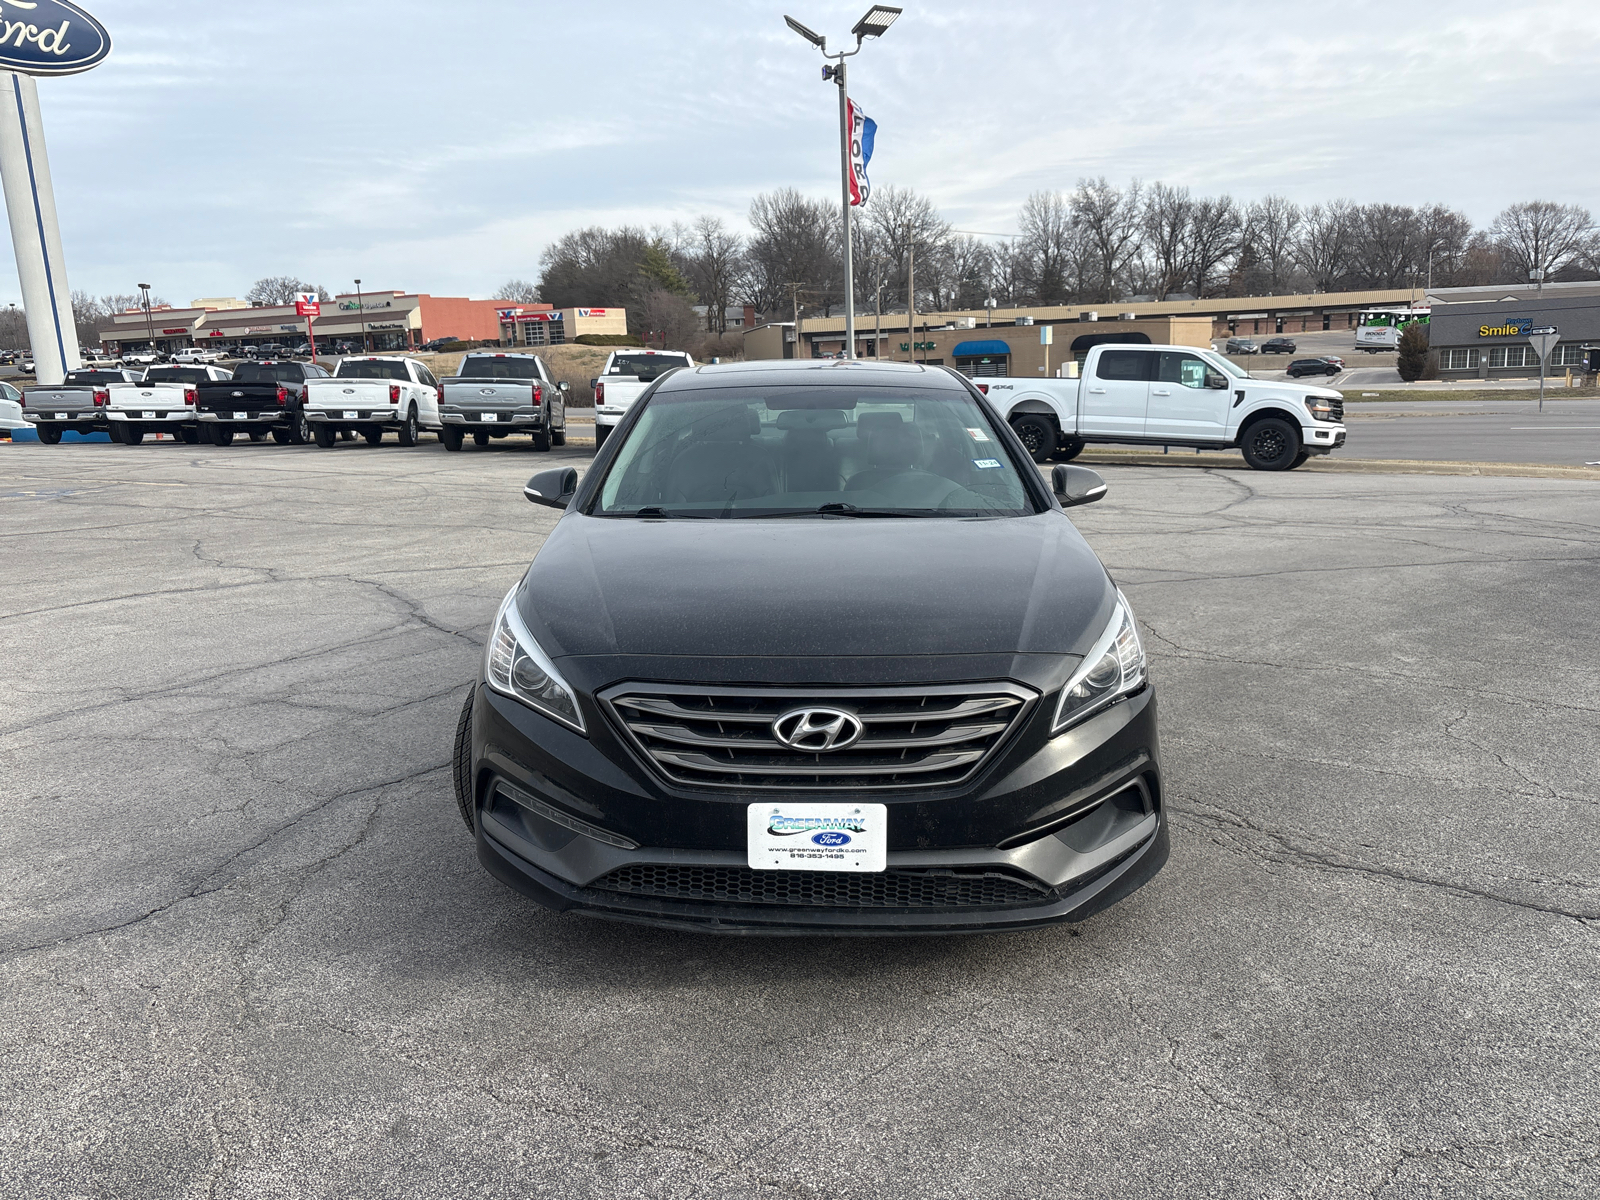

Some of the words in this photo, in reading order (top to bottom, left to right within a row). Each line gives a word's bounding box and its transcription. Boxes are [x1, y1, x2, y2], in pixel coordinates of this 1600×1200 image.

[0, 0, 71, 55] ord
[852, 115, 869, 202] FORD
[1479, 324, 1519, 336] Smile
[769, 815, 865, 830] GREENWAY
[819, 833, 843, 844] Ford
